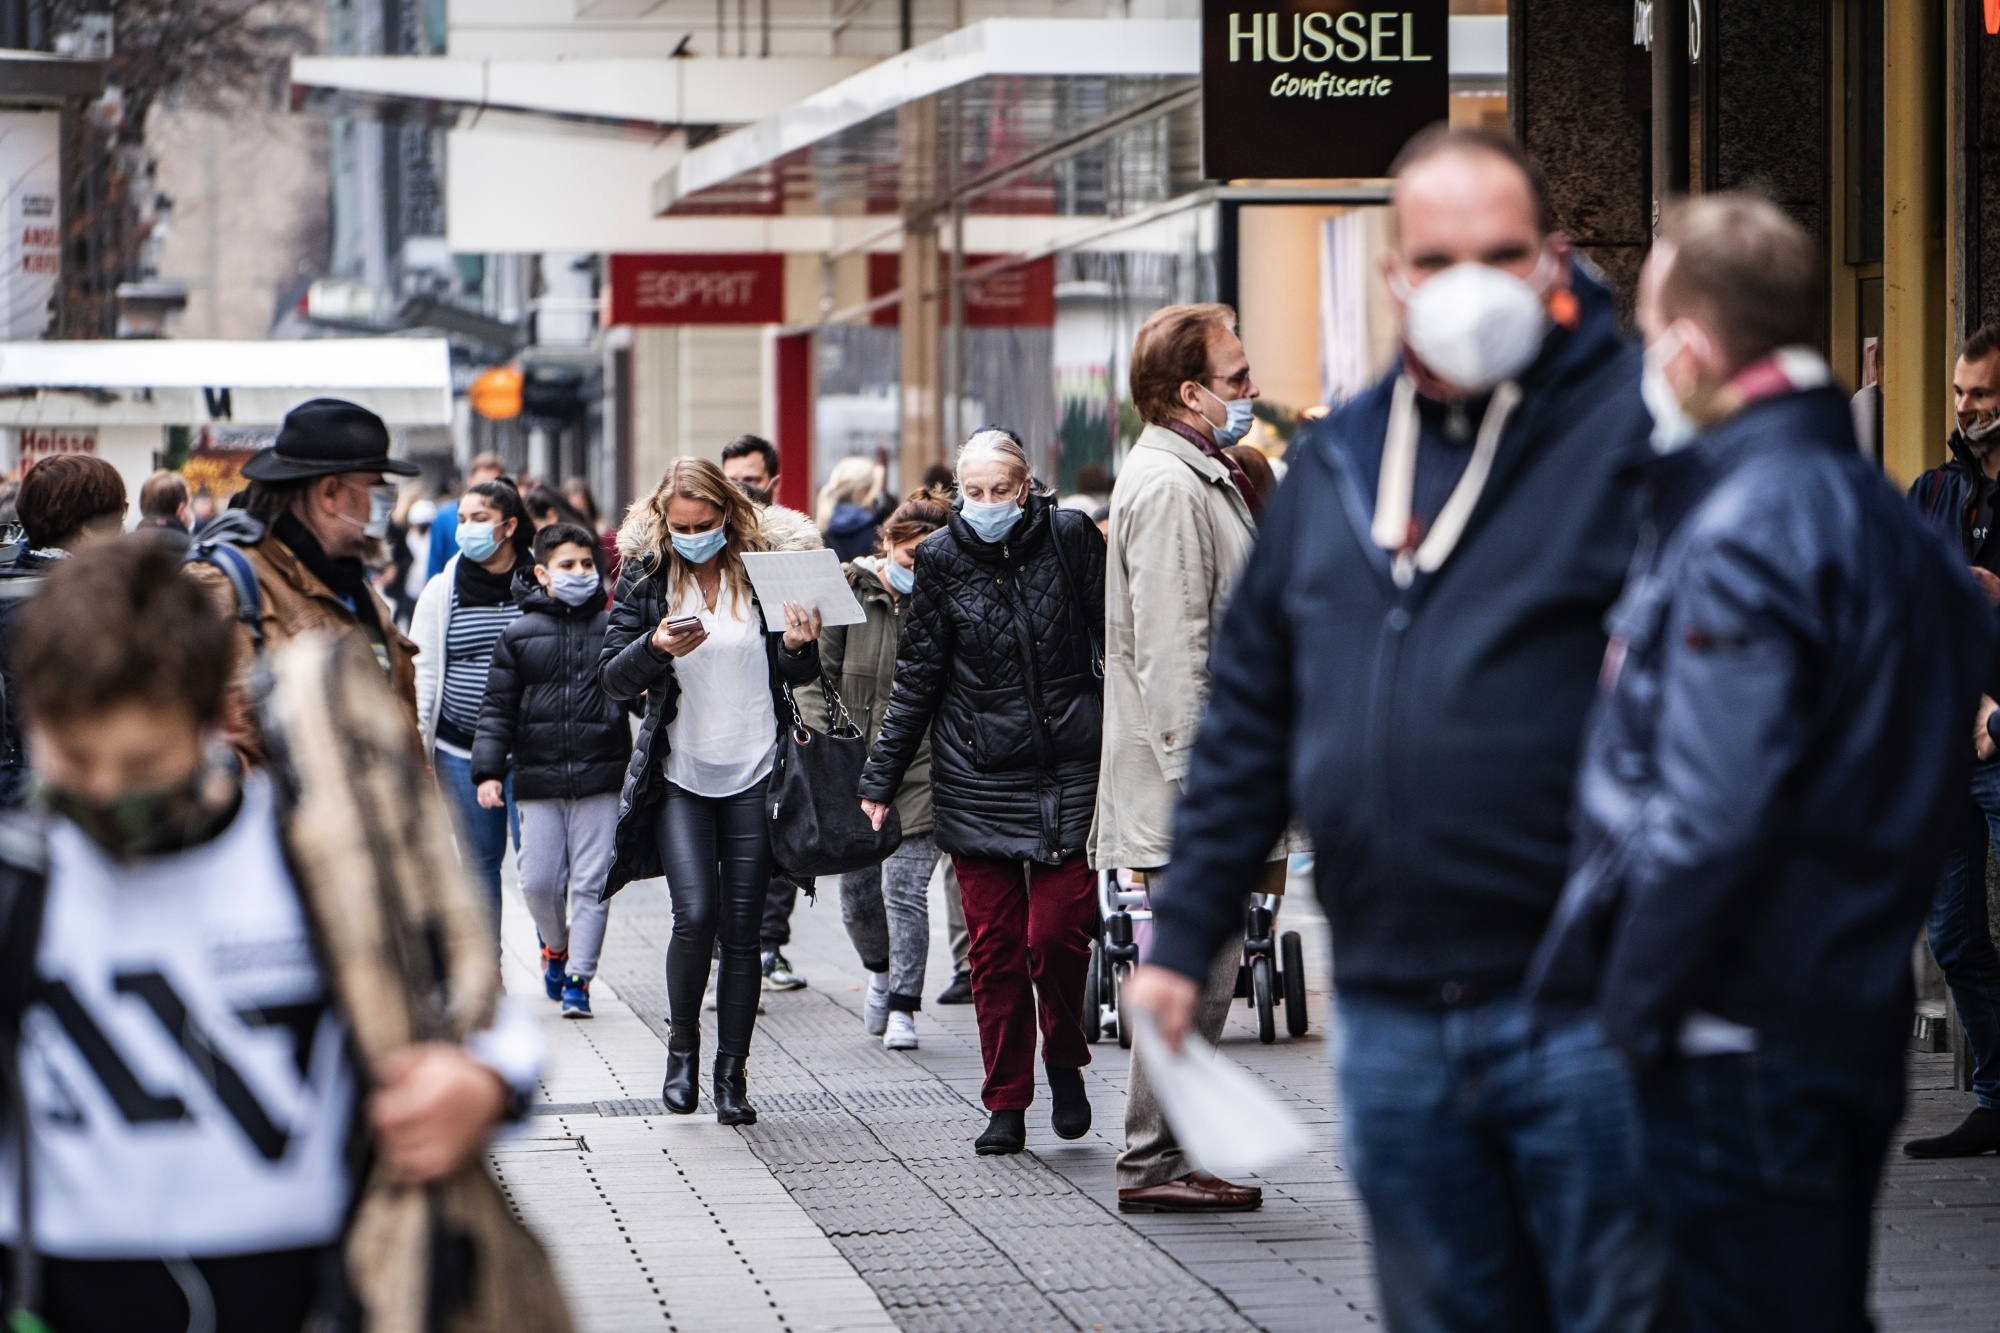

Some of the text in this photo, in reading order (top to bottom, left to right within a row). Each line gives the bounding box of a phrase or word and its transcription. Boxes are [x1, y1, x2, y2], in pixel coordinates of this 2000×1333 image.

[1229, 12, 1433, 62] HUSSEL
[1270, 71, 1393, 100] Confiserie
[636, 270, 760, 307] ESPRIT
